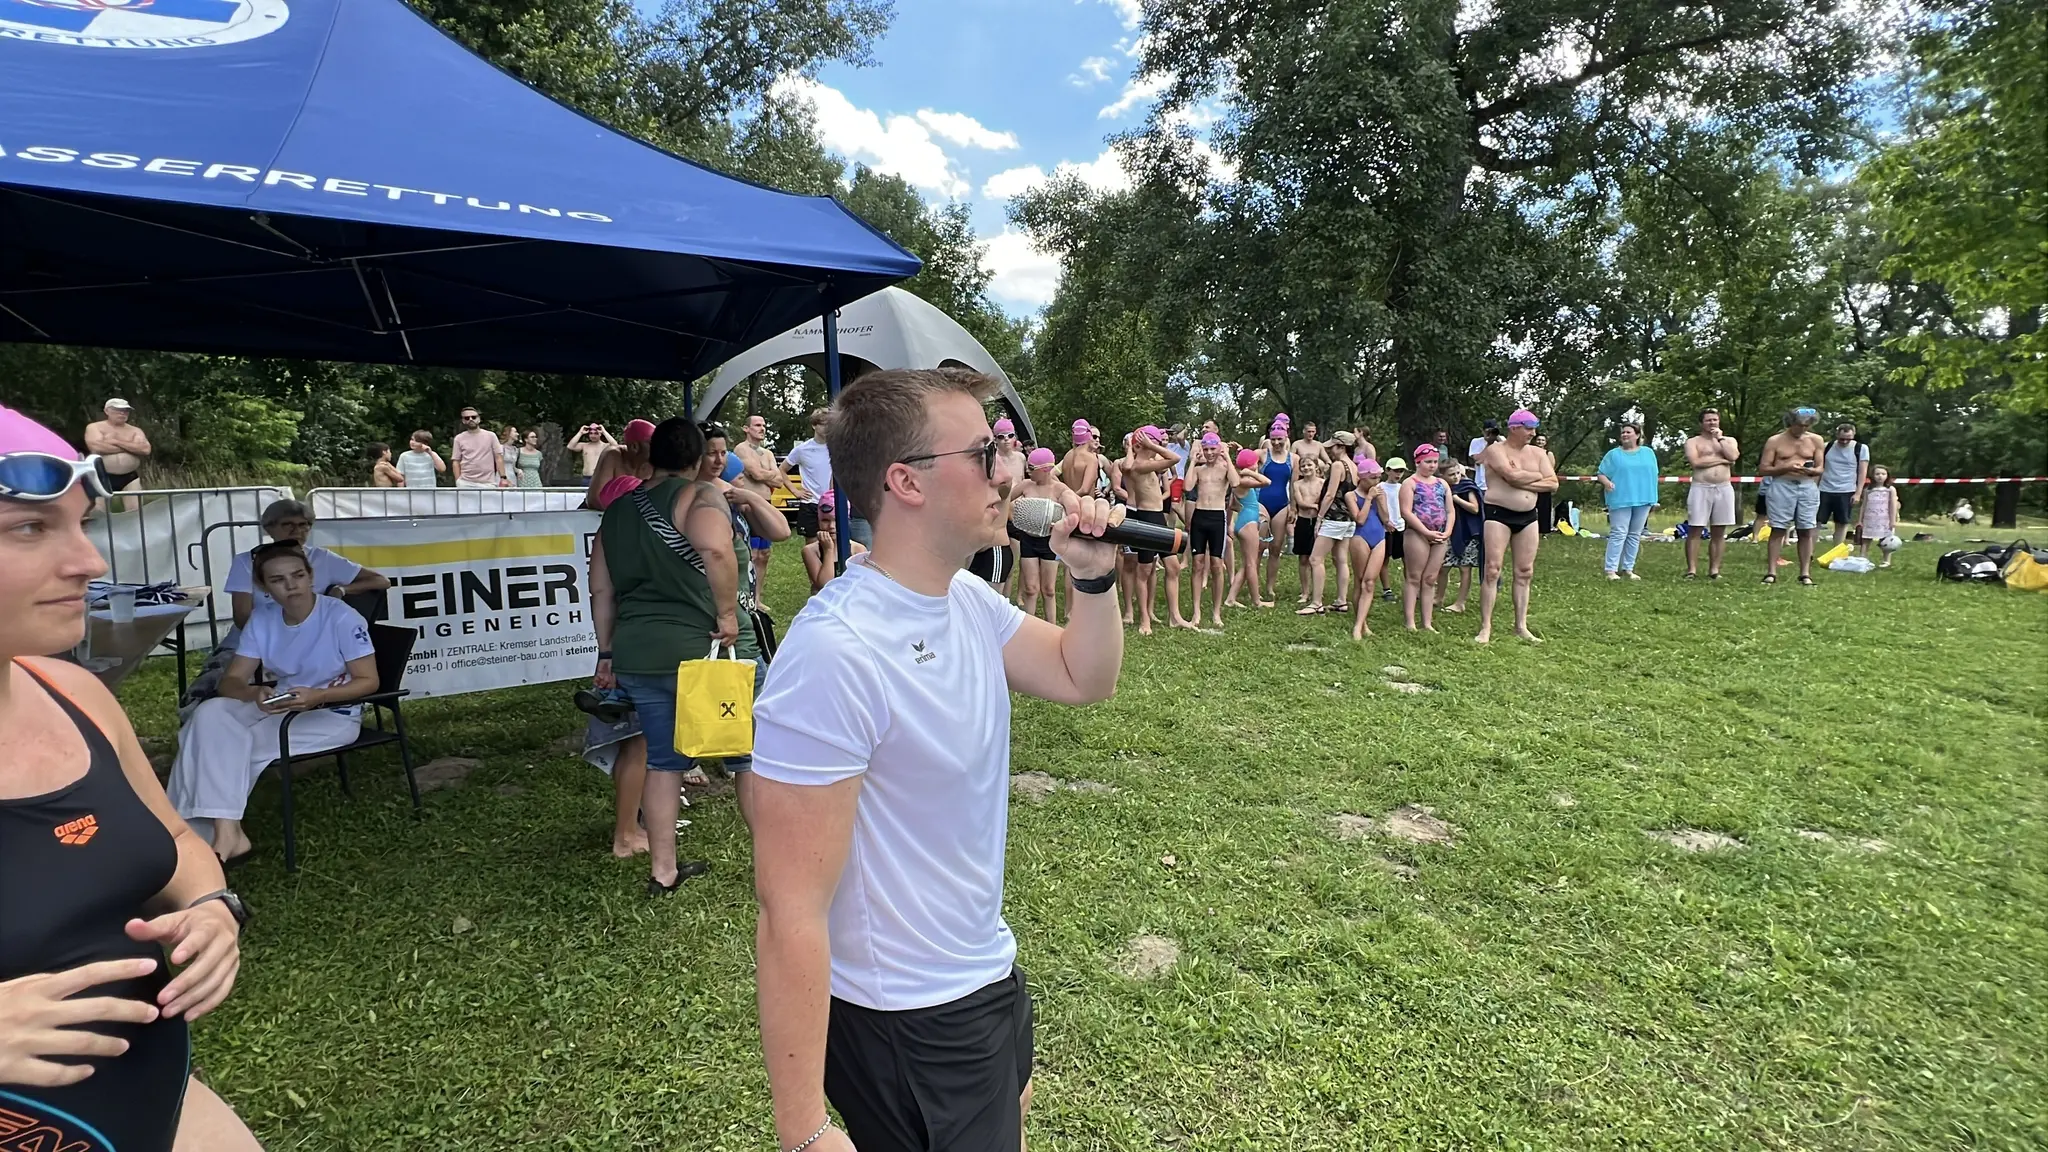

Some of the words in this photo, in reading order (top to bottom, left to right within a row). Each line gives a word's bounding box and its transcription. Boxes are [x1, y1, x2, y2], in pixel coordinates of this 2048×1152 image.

[0, 144, 613, 222] SSERRETTUNG
[794, 325, 873, 335] KAMMHOFER
[447, 642, 498, 657] ZENTRALE:
[500, 639, 537, 650] Kremser
[540, 633, 586, 646] Landstraße
[407, 662, 443, 674] 5491-0
[451, 649, 558, 669] office@steiner-bau.com
[915, 652, 936, 664] erima
[54, 814, 96, 837] arena
